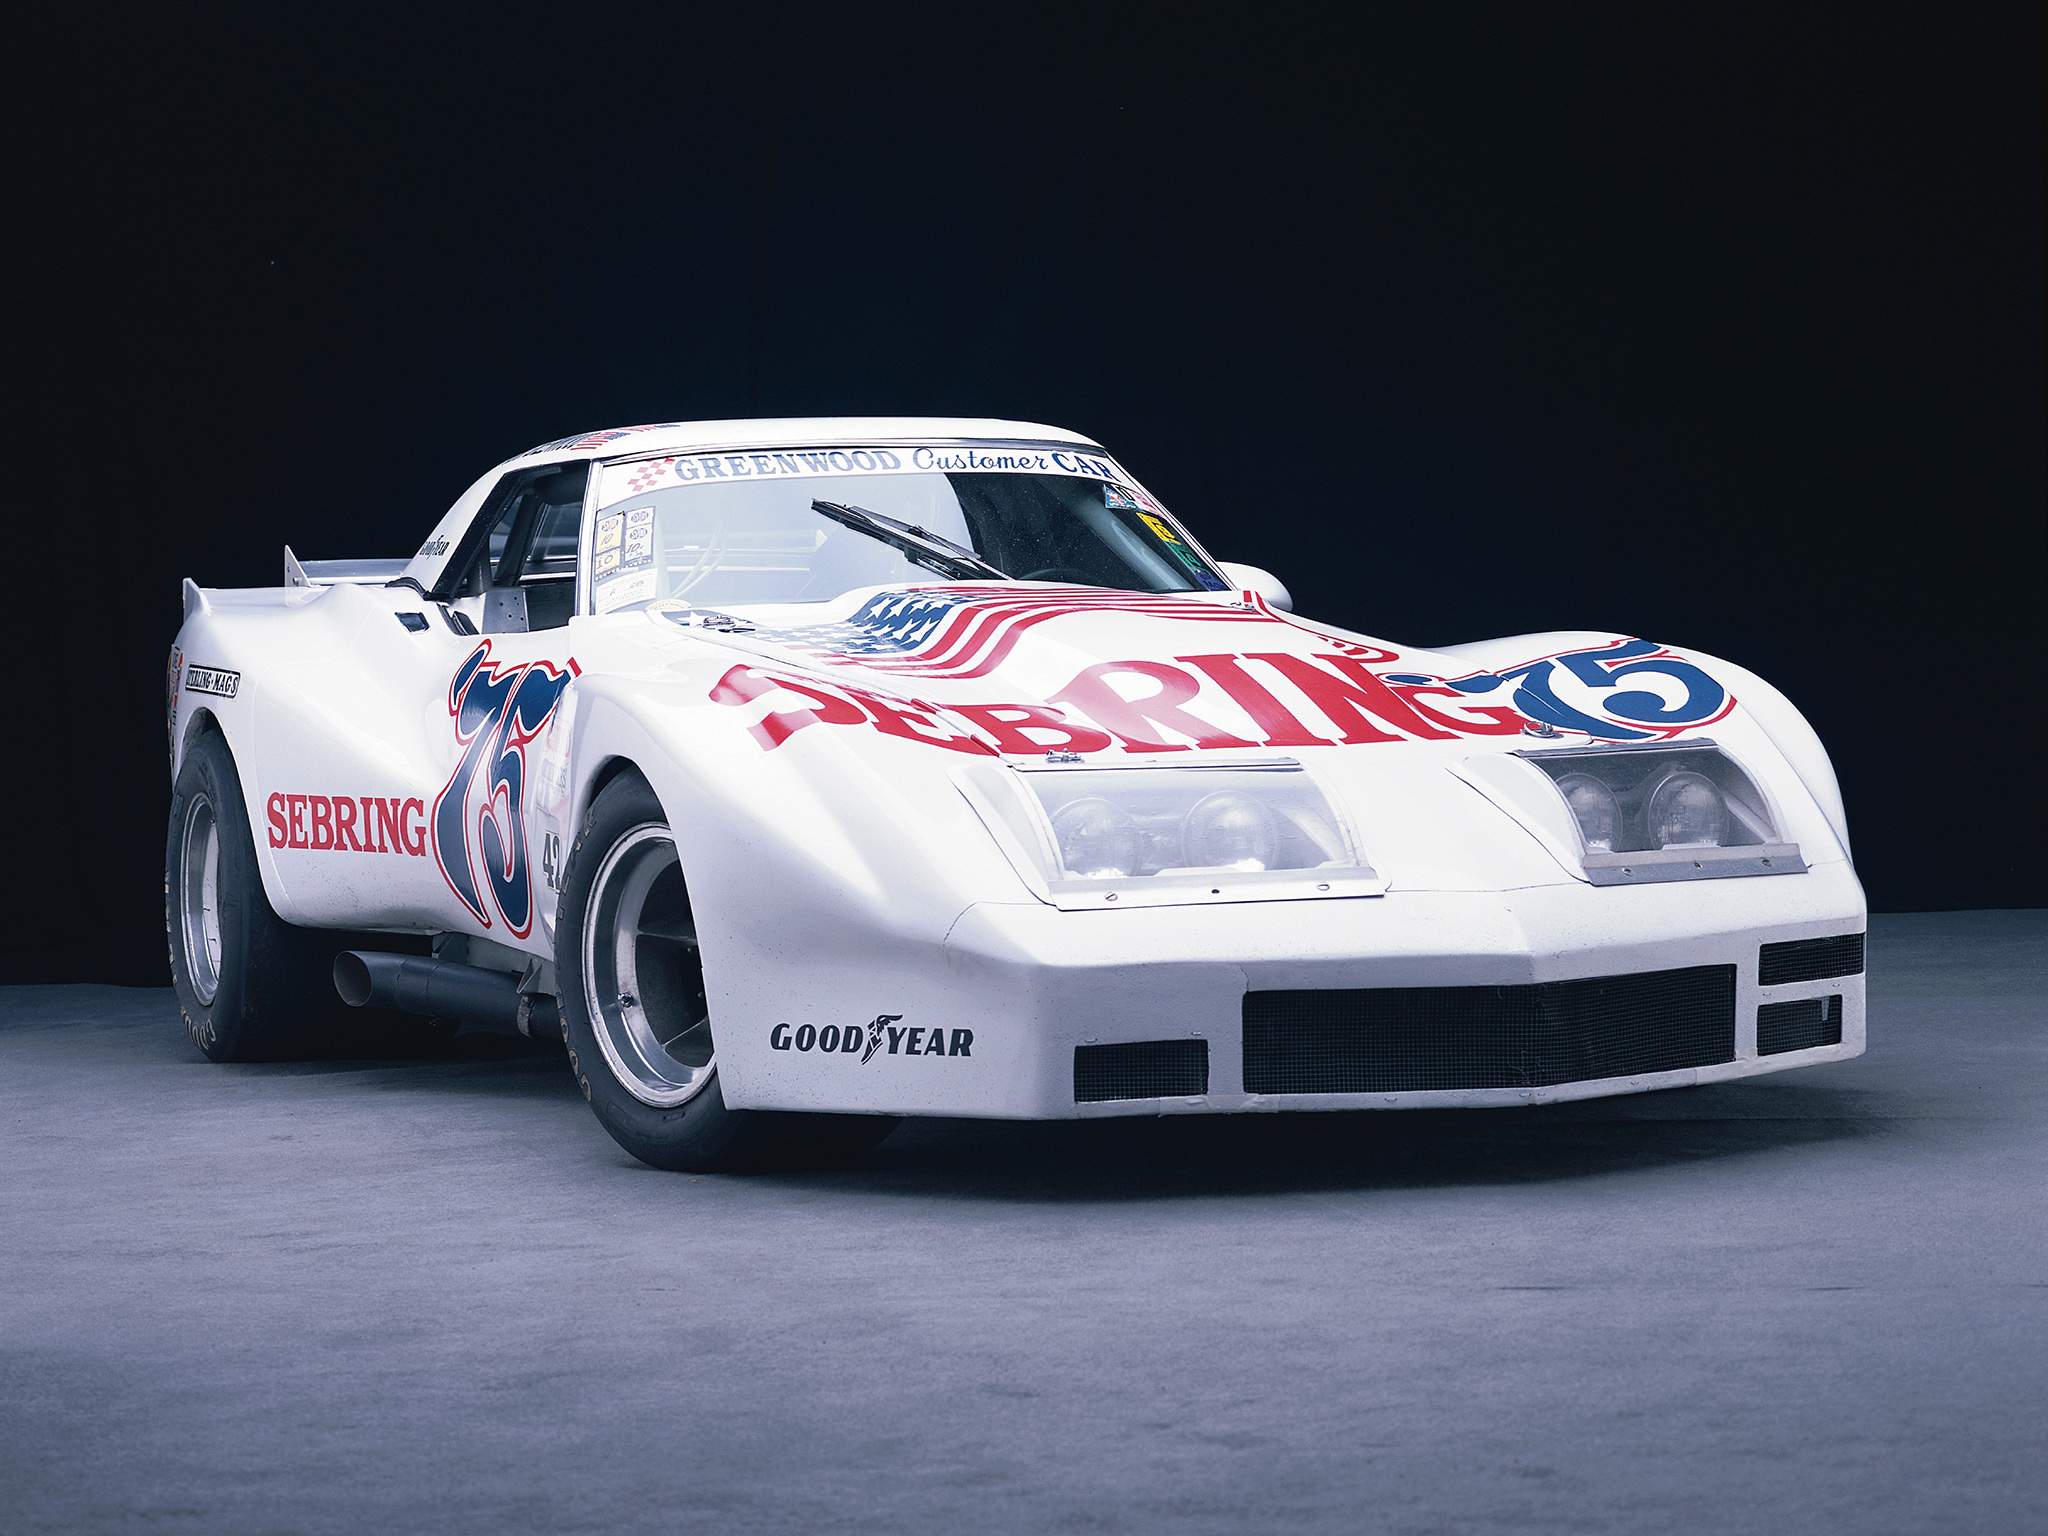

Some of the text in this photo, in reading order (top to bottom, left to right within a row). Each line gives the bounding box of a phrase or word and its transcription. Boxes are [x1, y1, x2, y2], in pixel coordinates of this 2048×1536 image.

[674, 447, 1122, 483] GREENWOOD Customer CAR
[709, 652, 1529, 753] SEBRING
[1376, 637, 1738, 744] 75
[267, 791, 427, 857] SEBRING
[431, 638, 583, 939] 75
